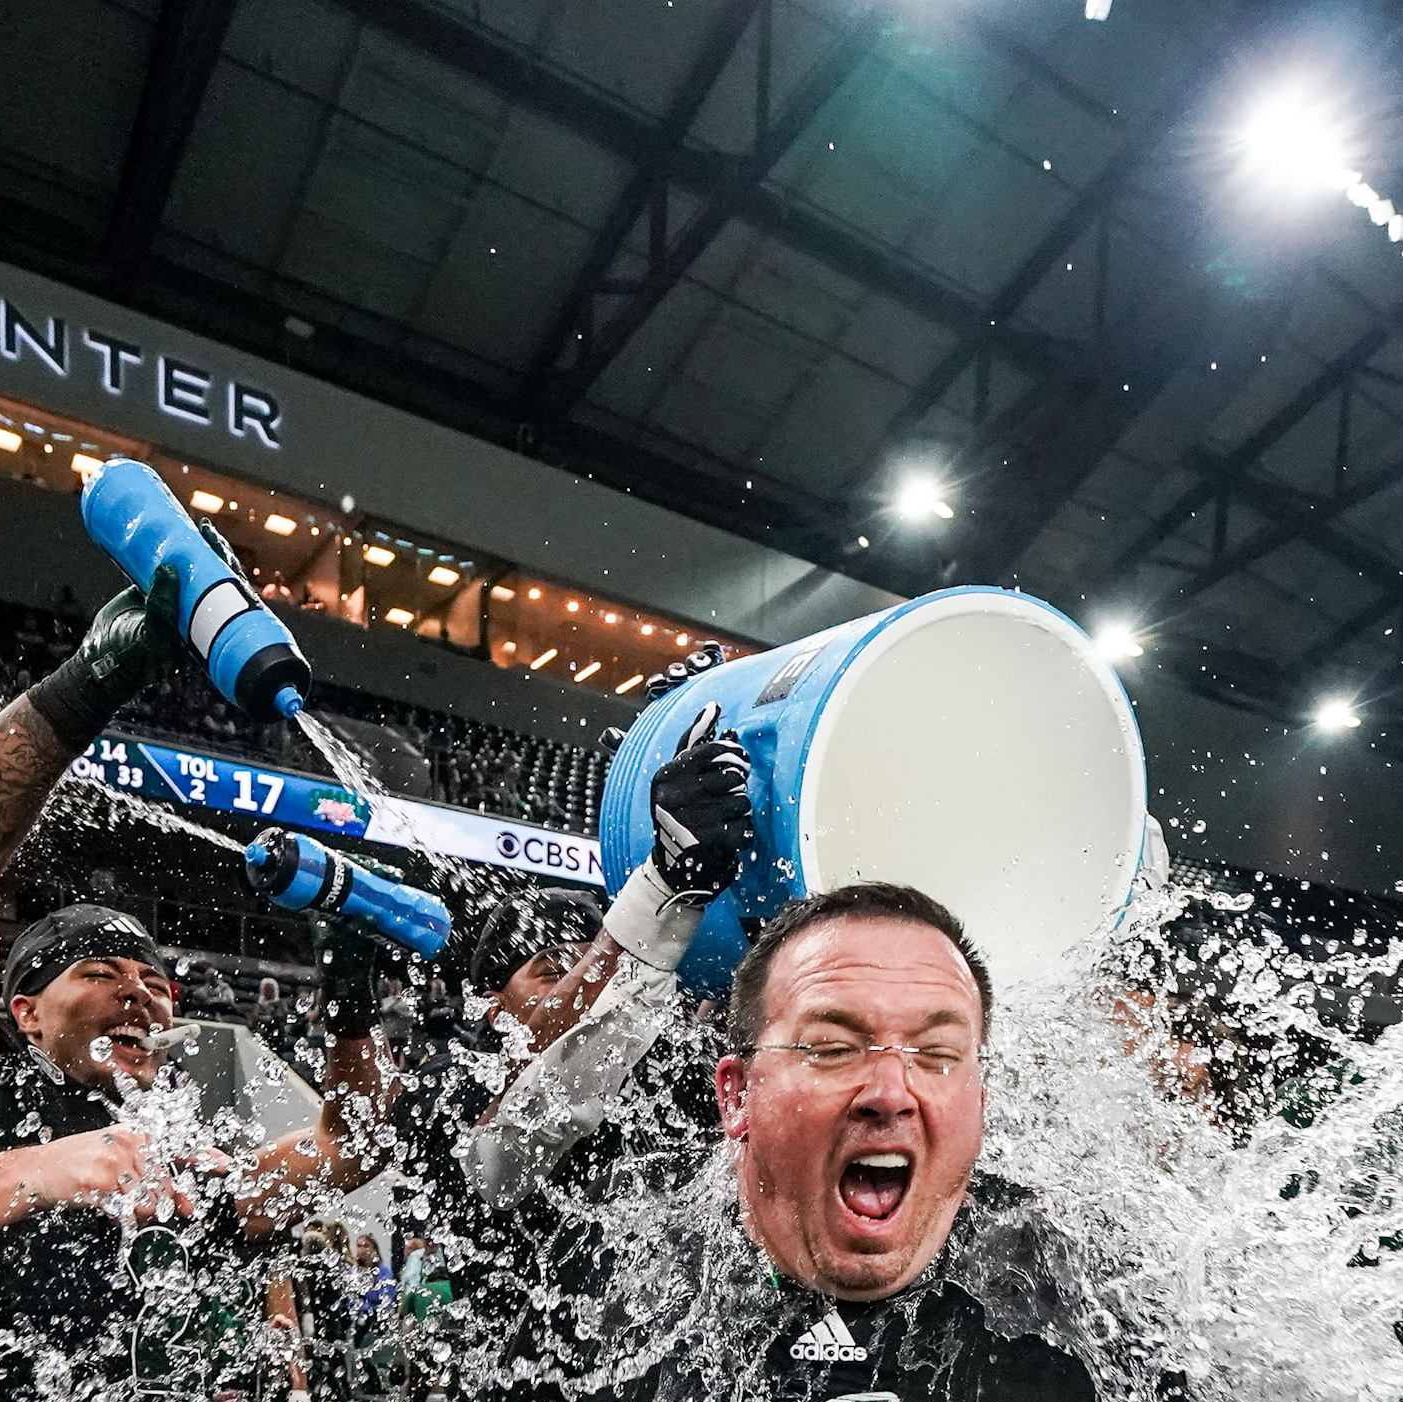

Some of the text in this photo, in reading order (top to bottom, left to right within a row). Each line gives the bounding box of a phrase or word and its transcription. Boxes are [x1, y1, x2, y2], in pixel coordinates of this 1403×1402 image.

[100, 740, 129, 764] 14
[117, 764, 144, 788] 33
[176, 753, 219, 782] TOL
[189, 778, 206, 801] 2
[232, 770, 285, 814] 17
[523, 838, 580, 871] CBS
[789, 1340, 868, 1362] adidas
